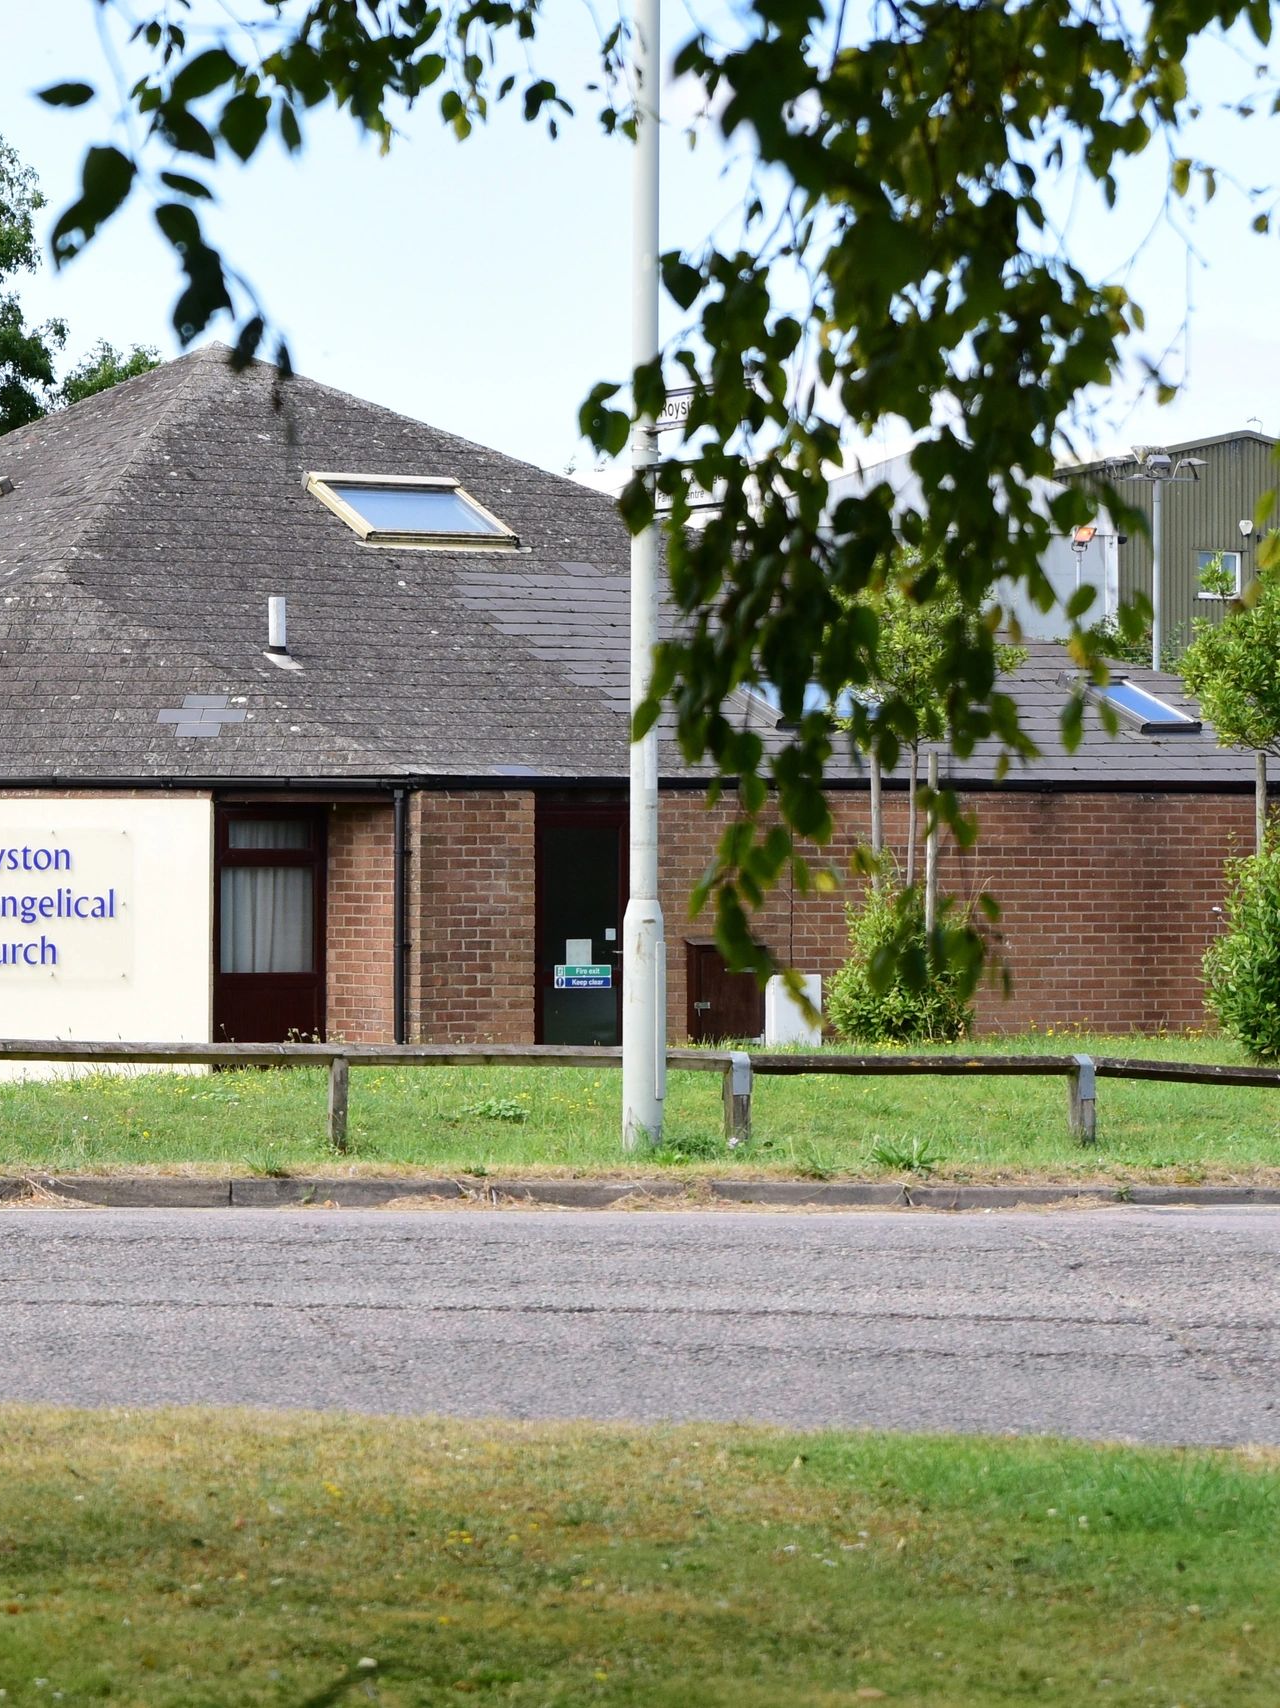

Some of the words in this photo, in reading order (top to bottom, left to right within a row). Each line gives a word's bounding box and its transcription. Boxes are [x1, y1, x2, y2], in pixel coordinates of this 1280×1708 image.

[575, 967, 587, 975] Fire
[588, 967, 600, 975] exit
[571, 979, 587, 987] Keep
